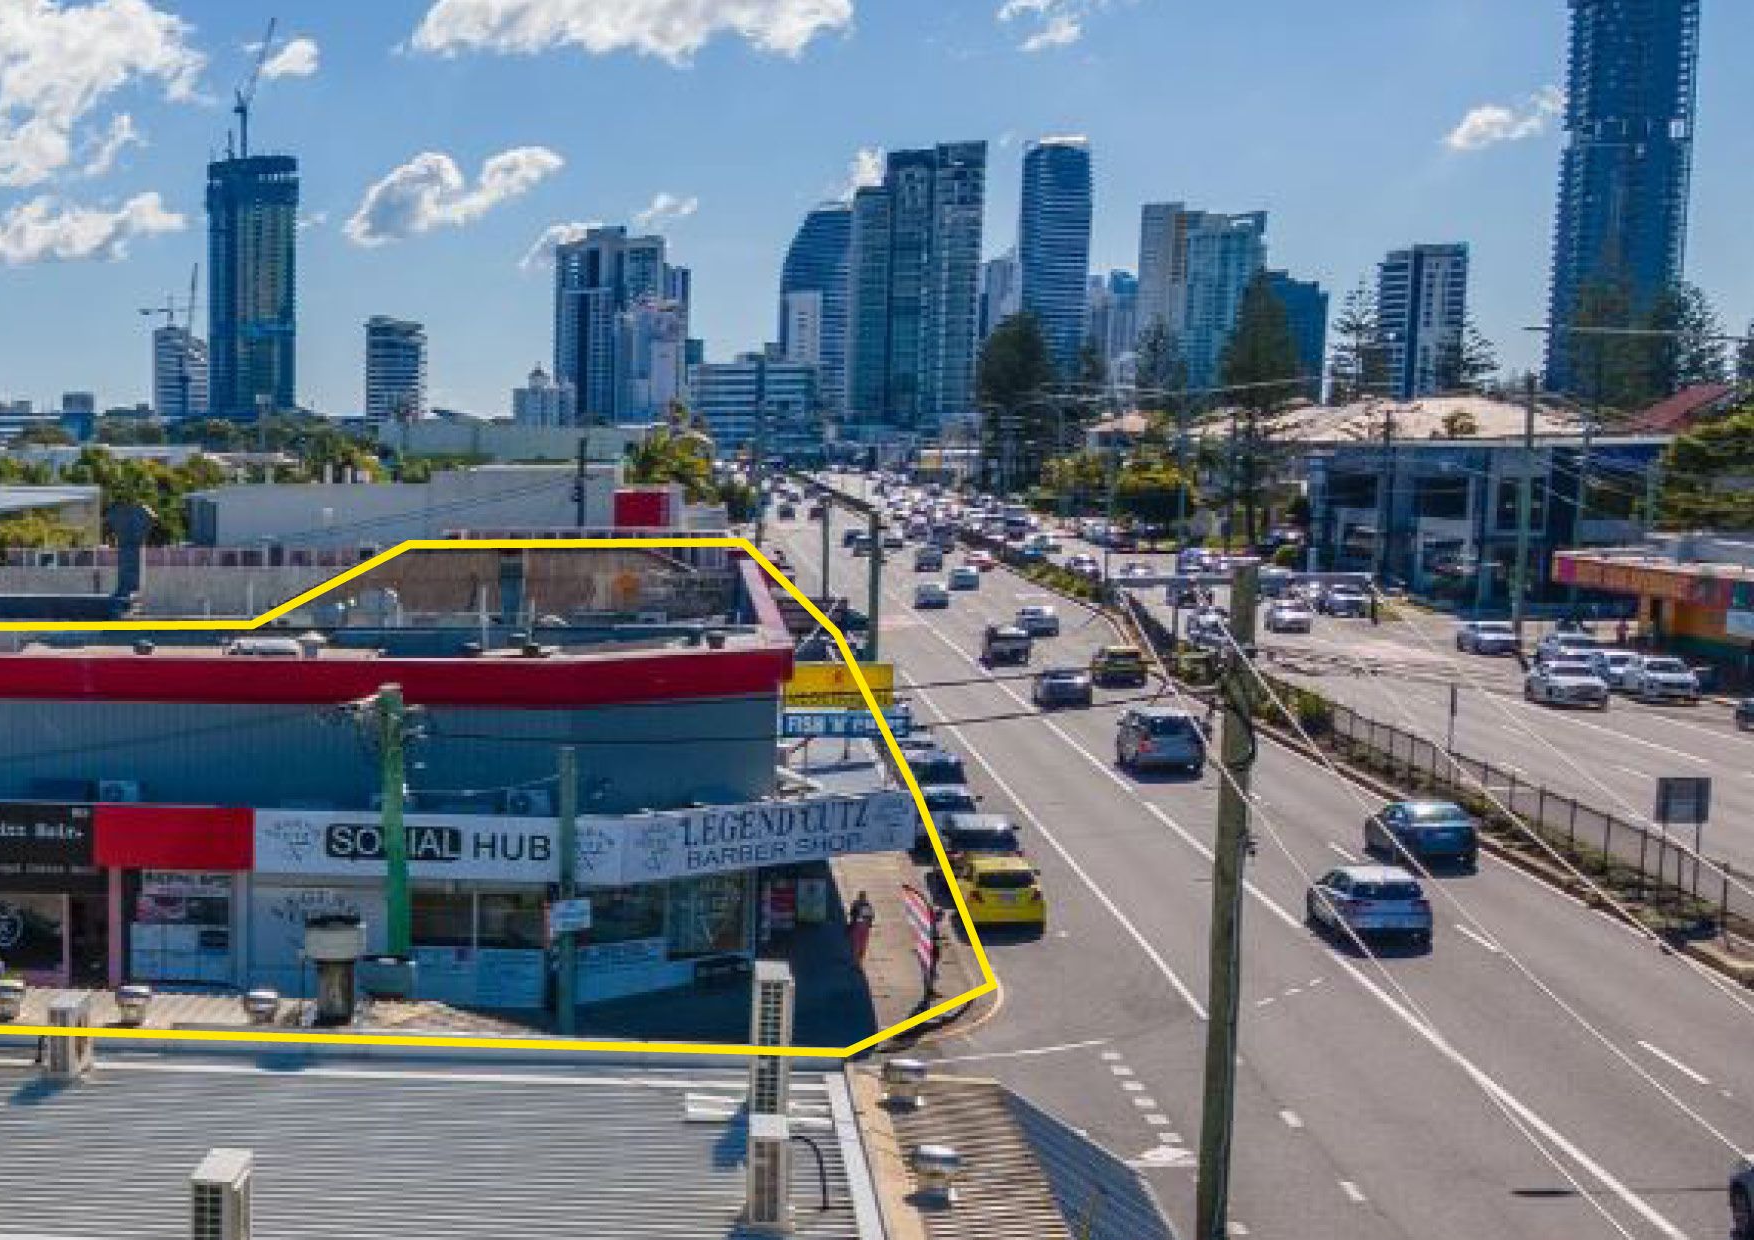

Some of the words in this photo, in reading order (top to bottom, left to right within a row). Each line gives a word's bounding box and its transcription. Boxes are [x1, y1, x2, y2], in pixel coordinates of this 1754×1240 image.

[330, 825, 460, 858] SOIAL
[472, 832, 552, 862] HUB
[686, 839, 788, 870] BARBER
